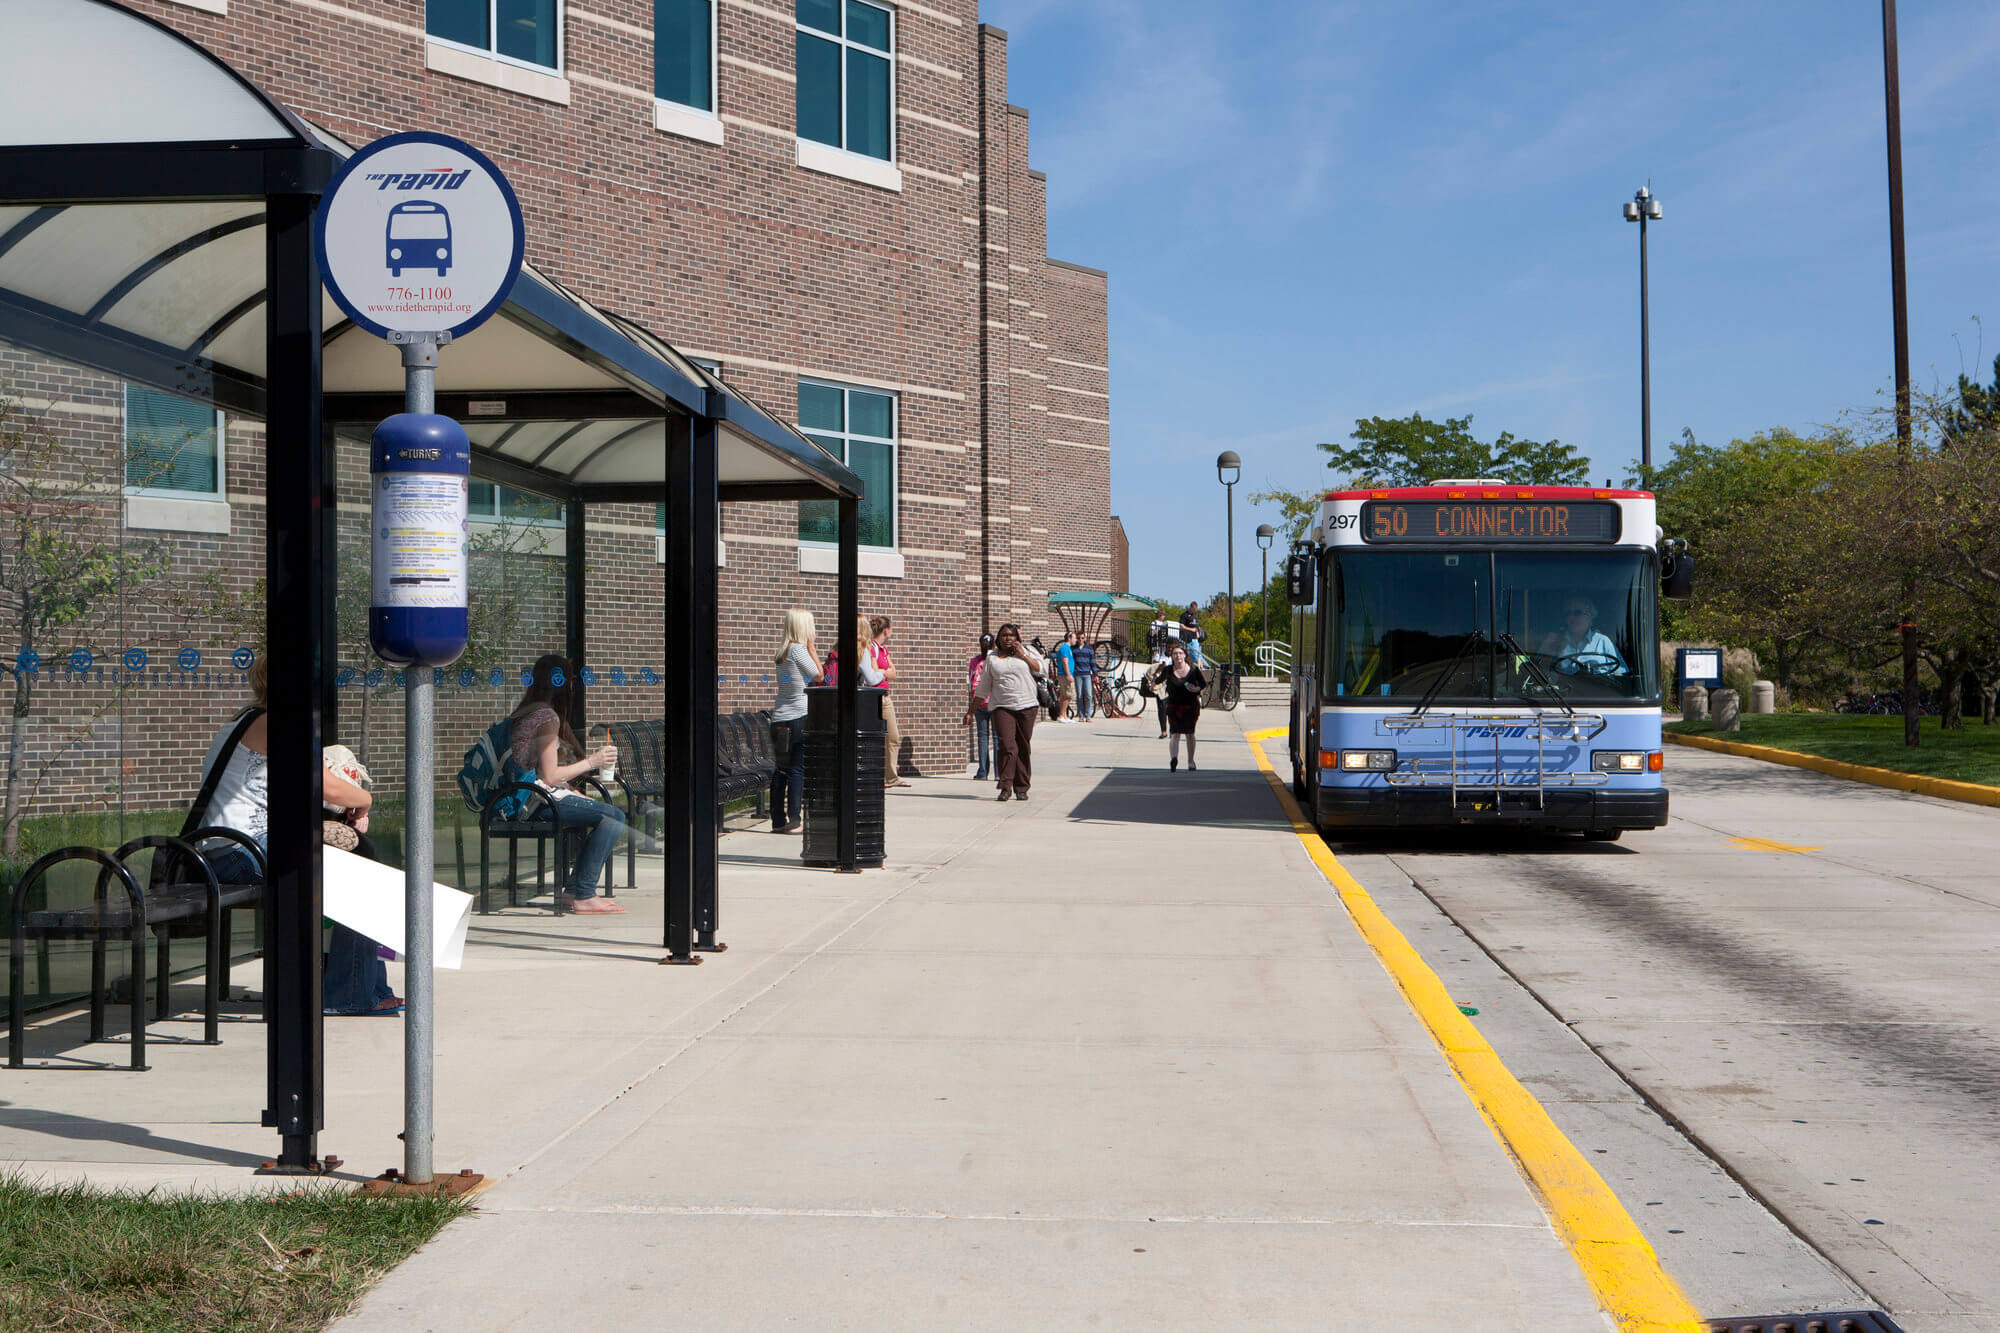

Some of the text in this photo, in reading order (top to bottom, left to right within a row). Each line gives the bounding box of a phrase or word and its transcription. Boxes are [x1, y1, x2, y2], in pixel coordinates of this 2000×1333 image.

[378, 168, 472, 190] rapid
[387, 287, 452, 301] 776-1100
[367, 302, 472, 314] www.ridetherapid.org
[408, 448, 432, 459] TURN
[1328, 515, 1358, 529] 297
[1374, 506, 1569, 536] 50 CONNECTOR
